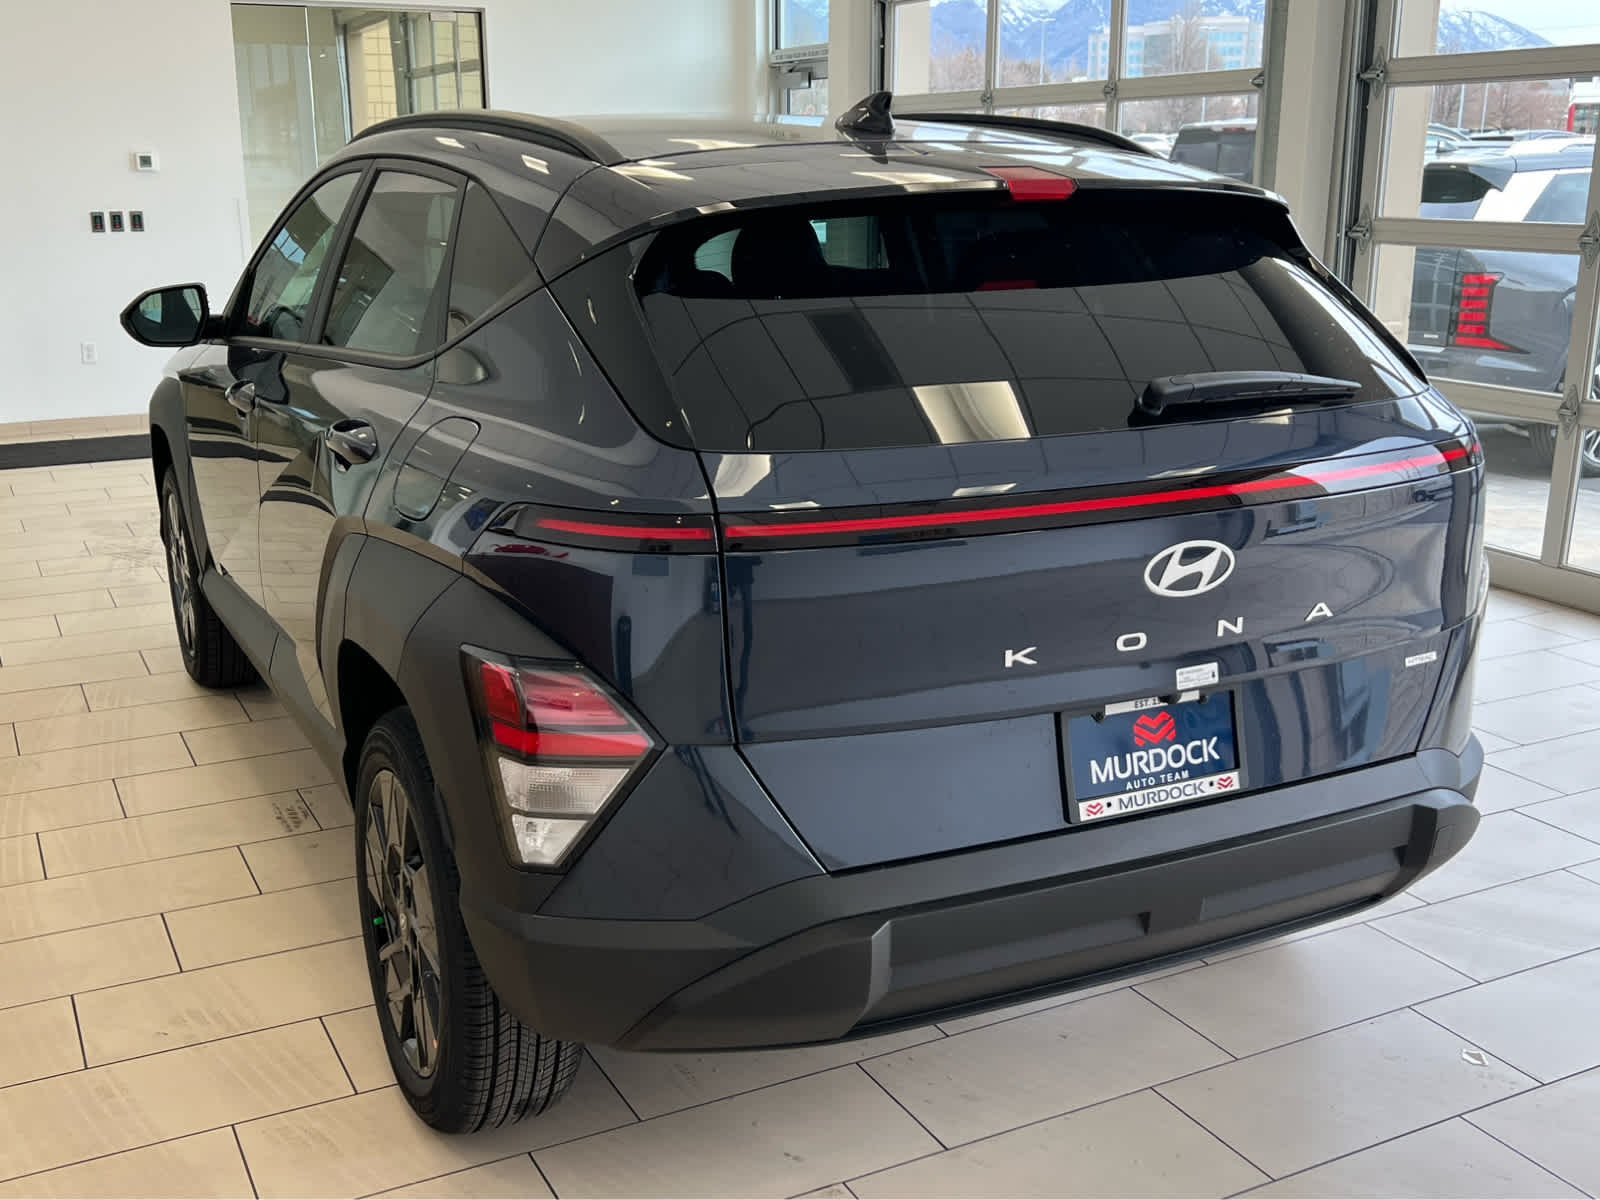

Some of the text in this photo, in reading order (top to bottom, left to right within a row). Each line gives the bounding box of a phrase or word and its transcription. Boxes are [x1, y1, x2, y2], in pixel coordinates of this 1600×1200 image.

[1004, 601, 1334, 668] KONA
[1090, 736, 1220, 785] MURDOCK
[1126, 769, 1190, 791] AUTO TEAM
[1118, 781, 1206, 811] MURDOCK
